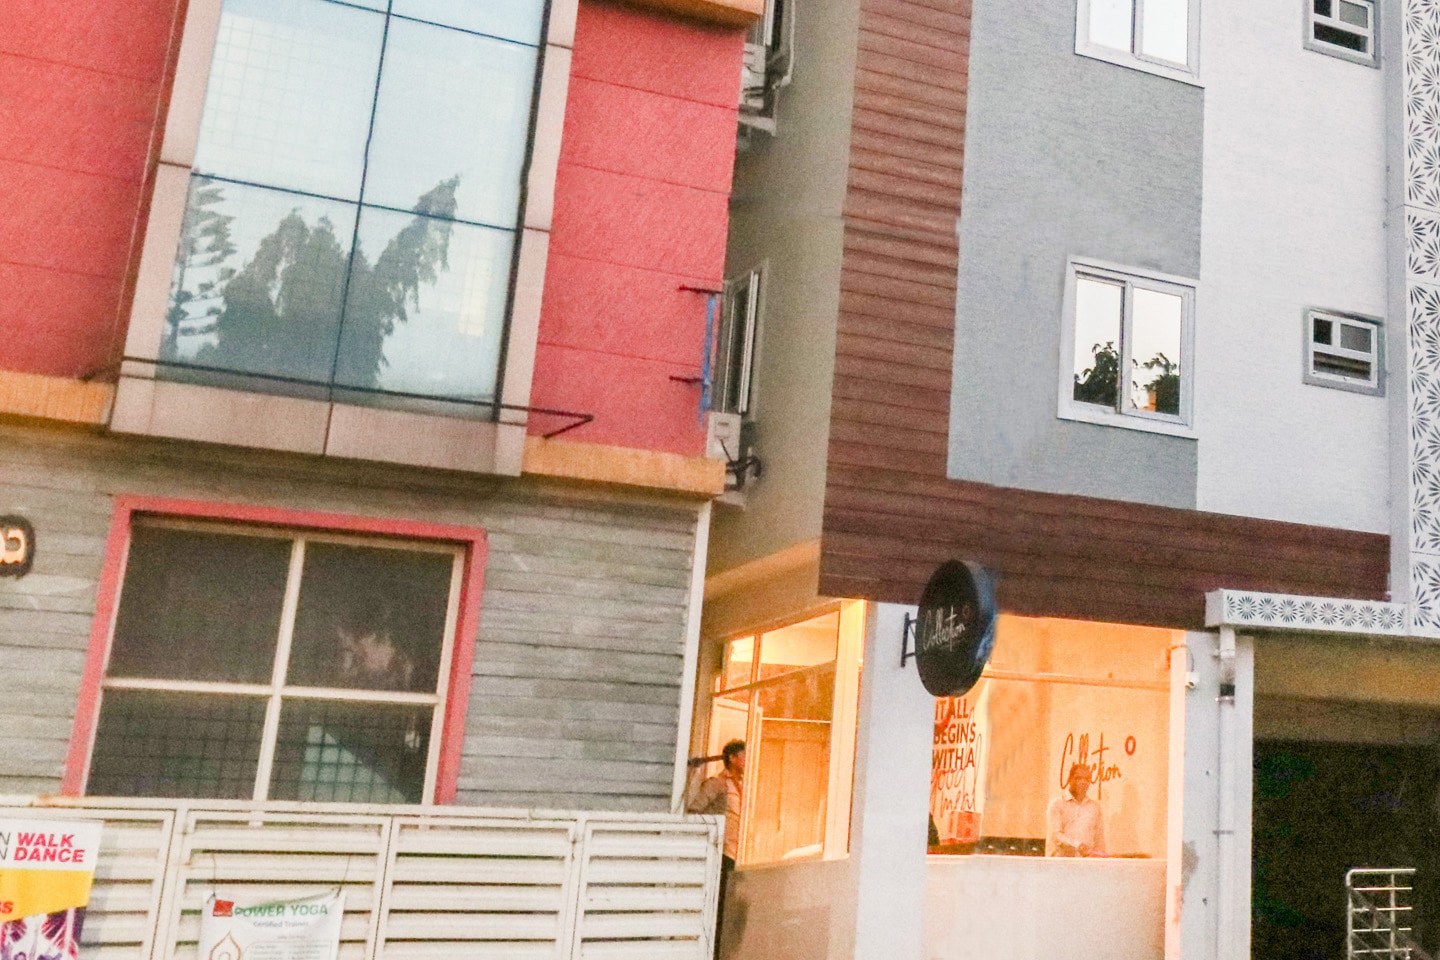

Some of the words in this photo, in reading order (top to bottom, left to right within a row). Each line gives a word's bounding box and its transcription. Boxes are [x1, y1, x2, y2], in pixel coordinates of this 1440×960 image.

[922, 604, 966, 653] Collection
[934, 699, 947, 721] IT
[950, 698, 969, 720] ALL
[933, 722, 977, 745] BEGINS
[932, 747, 964, 770] WITH
[965, 747, 976, 769] A
[17, 832, 75, 848] WALK
[14, 847, 86, 863] DANCE
[234, 904, 286, 917] POWER
[291, 904, 329, 916] YOGA
